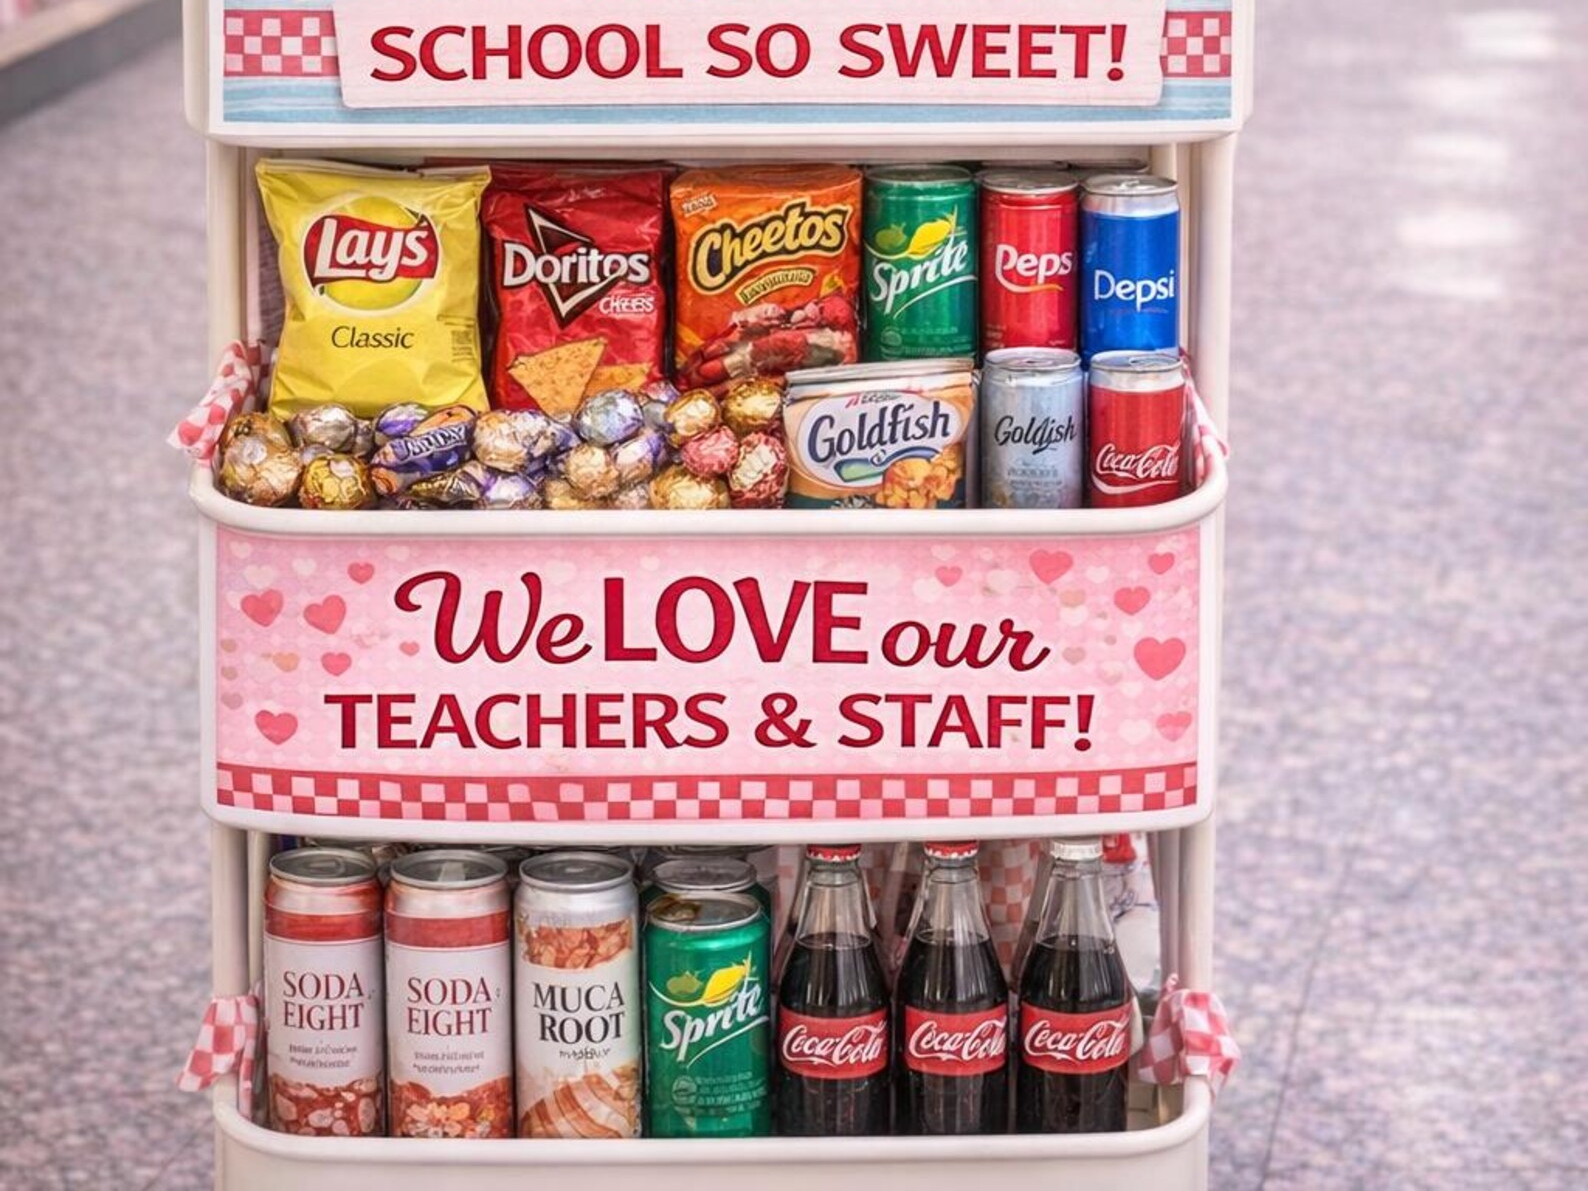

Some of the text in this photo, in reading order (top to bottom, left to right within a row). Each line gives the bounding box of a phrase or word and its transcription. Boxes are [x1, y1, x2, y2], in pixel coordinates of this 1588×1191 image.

[370, 21, 1127, 82] SCHOOL SO SWEET!
[503, 242, 650, 287] Doritos
[694, 206, 845, 289] Cheetos
[869, 235, 968, 316] Sprite
[331, 325, 415, 349] Classic
[807, 400, 950, 464] Goldfish
[394, 570, 1050, 672] We LOVE our
[324, 692, 1096, 752] TEACHERS & STAFF!
[282, 970, 364, 1000] SODA
[406, 976, 492, 1006] SODA
[532, 981, 625, 1014] MUCA
[283, 1001, 364, 1031] EIGHT
[406, 1006, 493, 1037] EIGHT
[538, 1011, 625, 1045] ROOT
[782, 1018, 887, 1066] Coca-Cola
